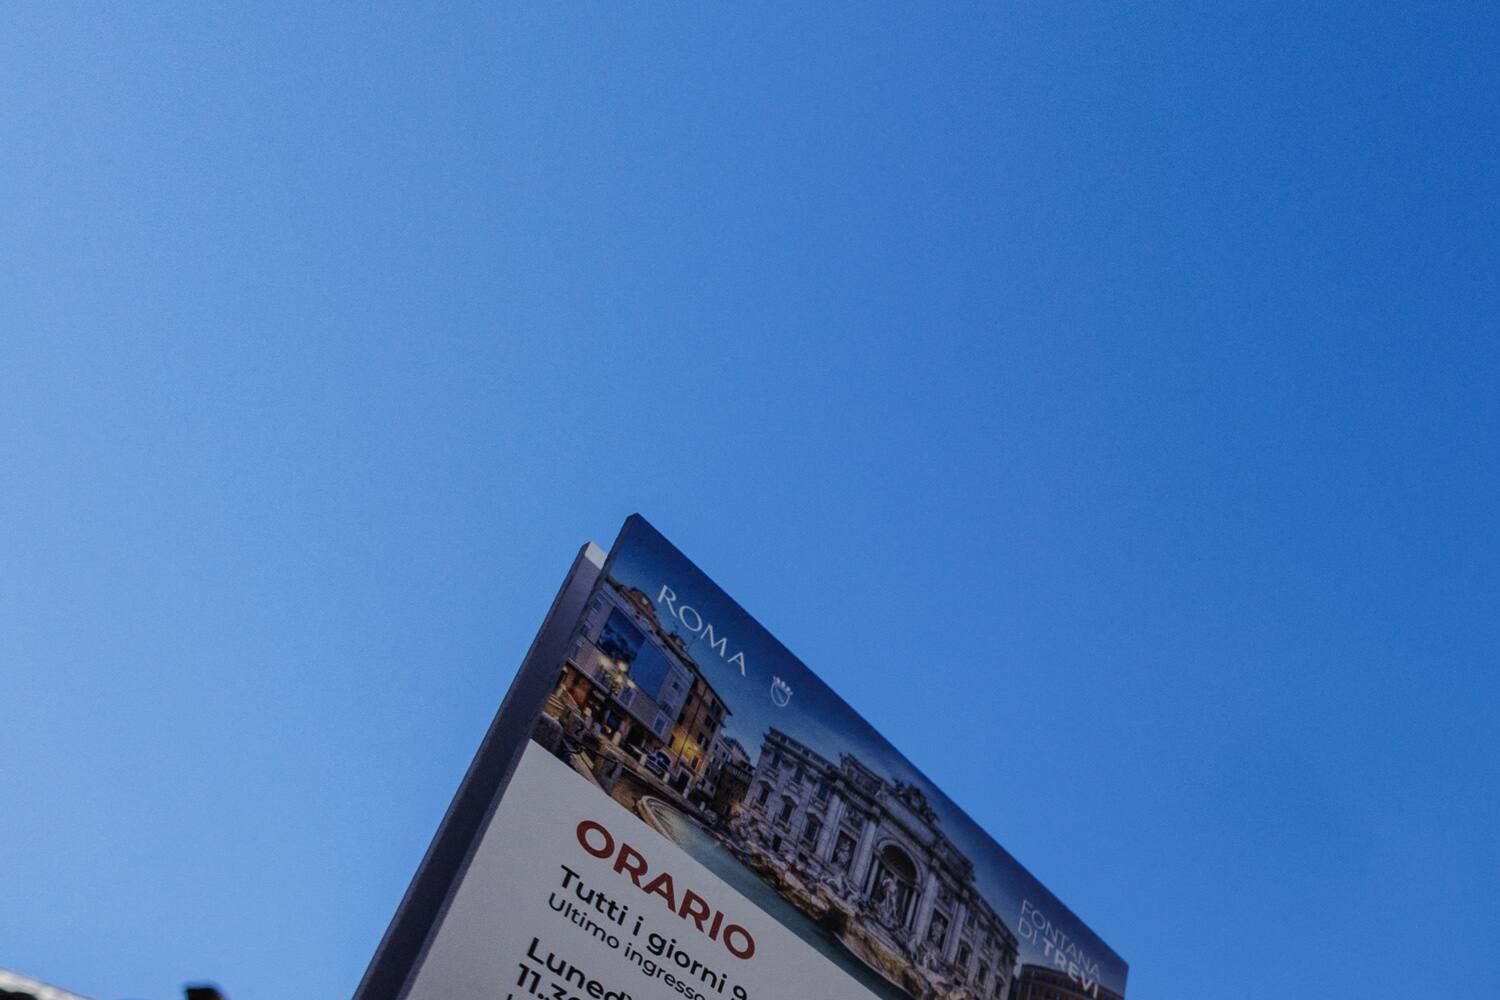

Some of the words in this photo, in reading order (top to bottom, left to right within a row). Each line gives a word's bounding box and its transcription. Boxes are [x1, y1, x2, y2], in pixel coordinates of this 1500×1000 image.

[658, 584, 746, 677] ROMA
[548, 893, 620, 949] Ultimo
[560, 864, 629, 926] Tutti
[632, 916, 644, 936] i
[646, 930, 728, 994] giorni
[576, 820, 756, 960] ORARIO
[1018, 917, 1037, 944] DI
[1043, 938, 1098, 999] TREVI
[1022, 899, 1100, 979] FONTANA
